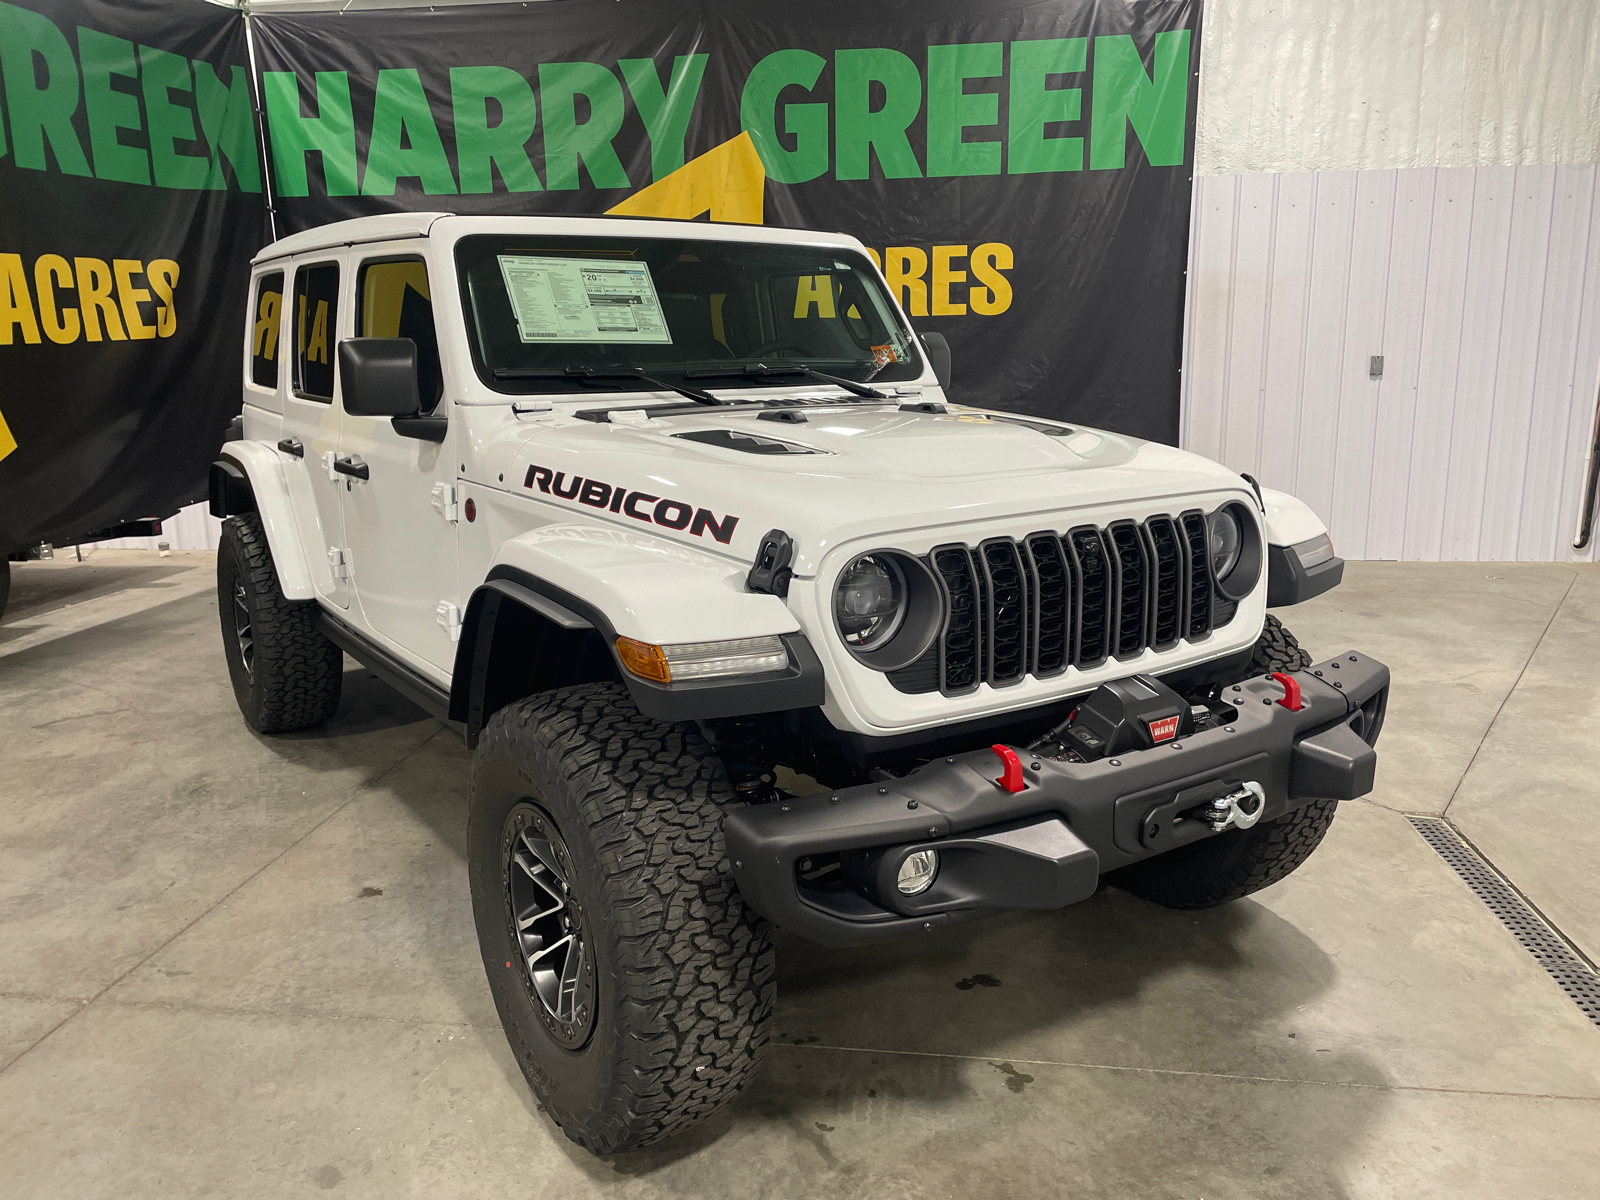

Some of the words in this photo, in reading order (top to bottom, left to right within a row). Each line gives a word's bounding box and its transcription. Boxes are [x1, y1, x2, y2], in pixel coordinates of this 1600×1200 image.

[0, 1, 262, 194] REEN
[263, 53, 709, 198] HARRY
[740, 29, 1191, 185] GREEN
[0, 252, 180, 346] ACRES
[793, 242, 1014, 319] ARES
[523, 464, 740, 545] RUBICON
[1154, 723, 1174, 736] WARN
